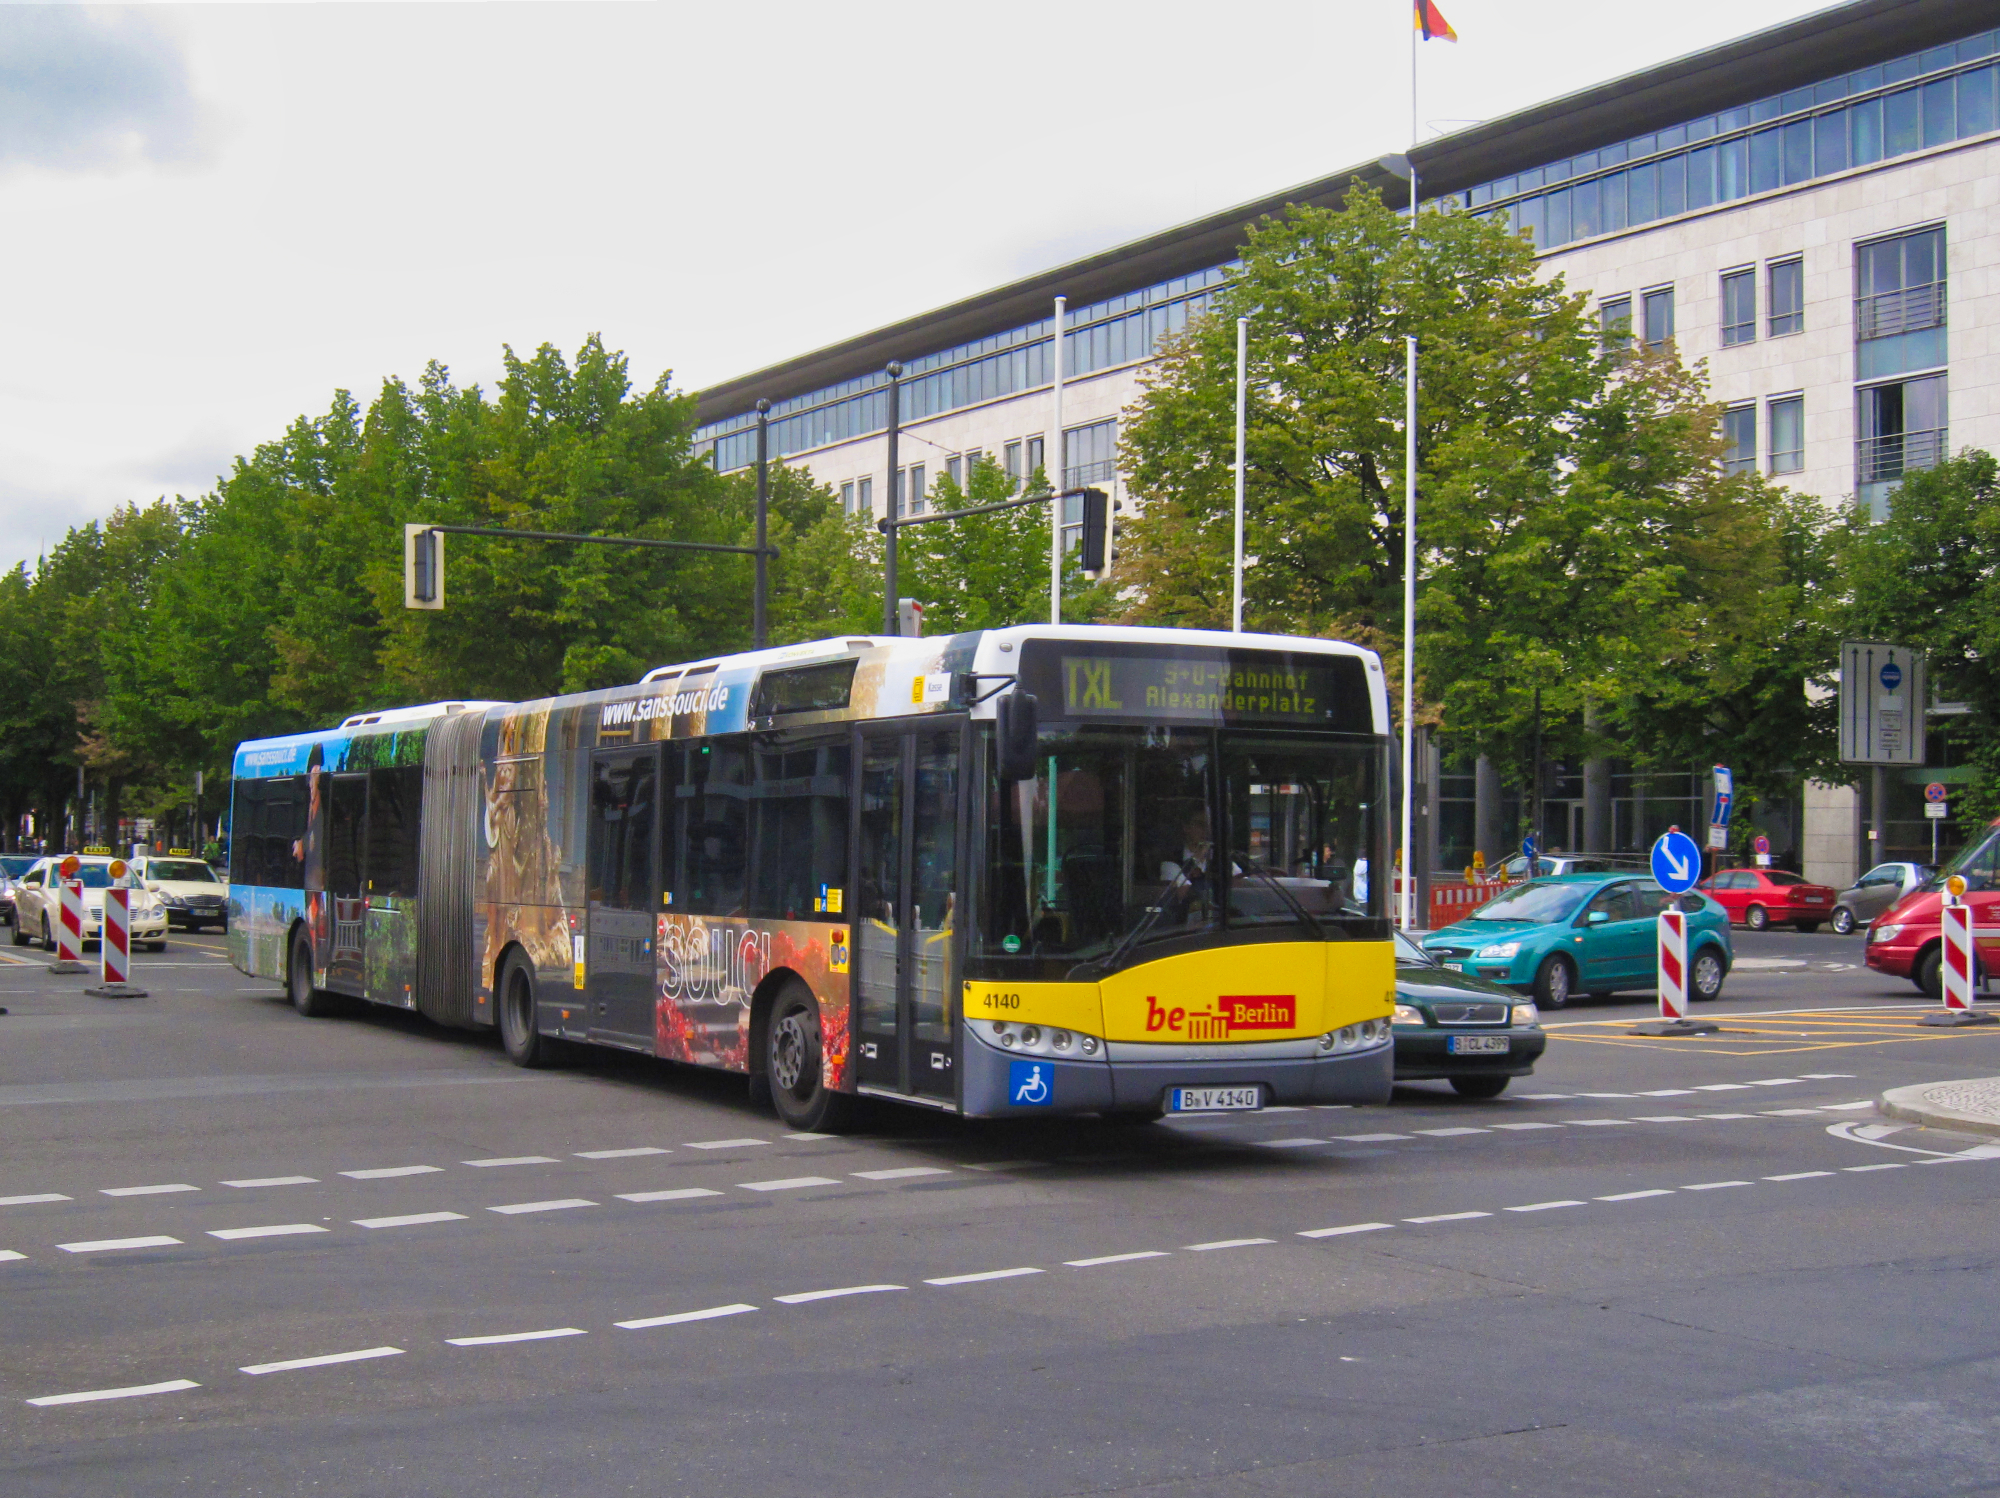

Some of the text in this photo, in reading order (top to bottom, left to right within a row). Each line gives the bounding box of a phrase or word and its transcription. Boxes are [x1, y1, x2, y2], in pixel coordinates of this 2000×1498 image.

[1064, 658, 1123, 710] TXL
[1146, 685, 1316, 714] Alexanderplatz
[602, 680, 729, 726] www.sanssouci.de
[983, 993, 1020, 1009] 4140
[1145, 996, 1289, 1032] be Berlin
[1184, 1089, 1254, 1107] B V 4140
